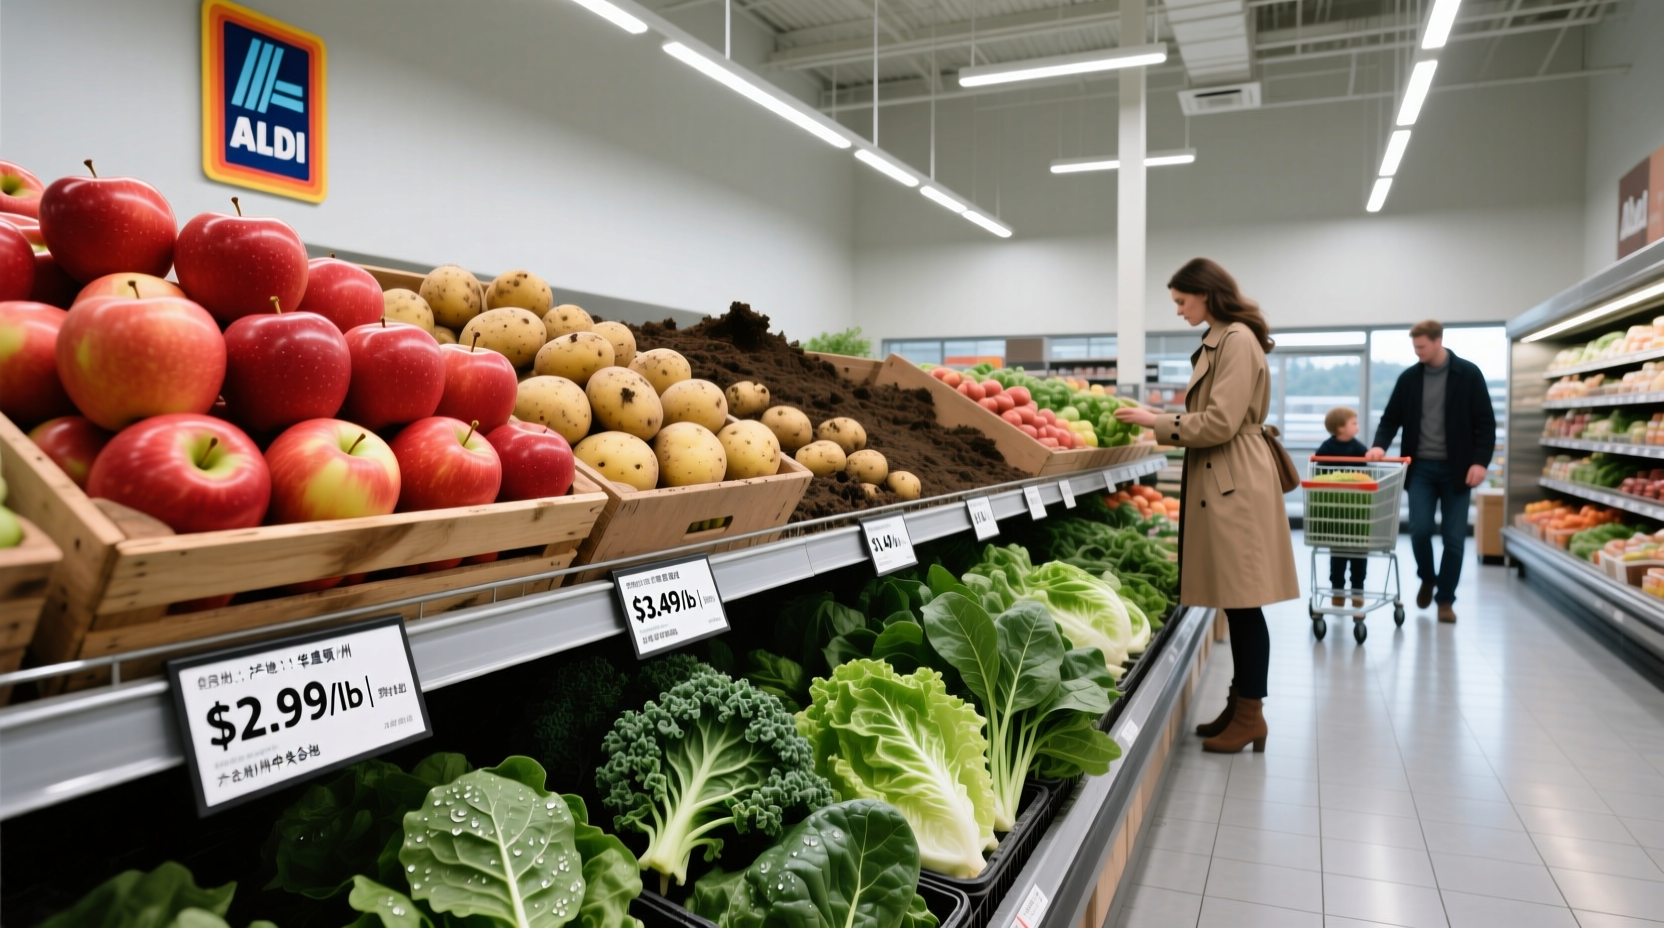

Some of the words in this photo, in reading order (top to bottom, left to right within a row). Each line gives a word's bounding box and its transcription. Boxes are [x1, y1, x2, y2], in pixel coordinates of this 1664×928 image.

[229, 115, 306, 164] ALDI
[632, 589, 698, 625] $3.49/lb
[206, 680, 364, 752] $2.99/lb
